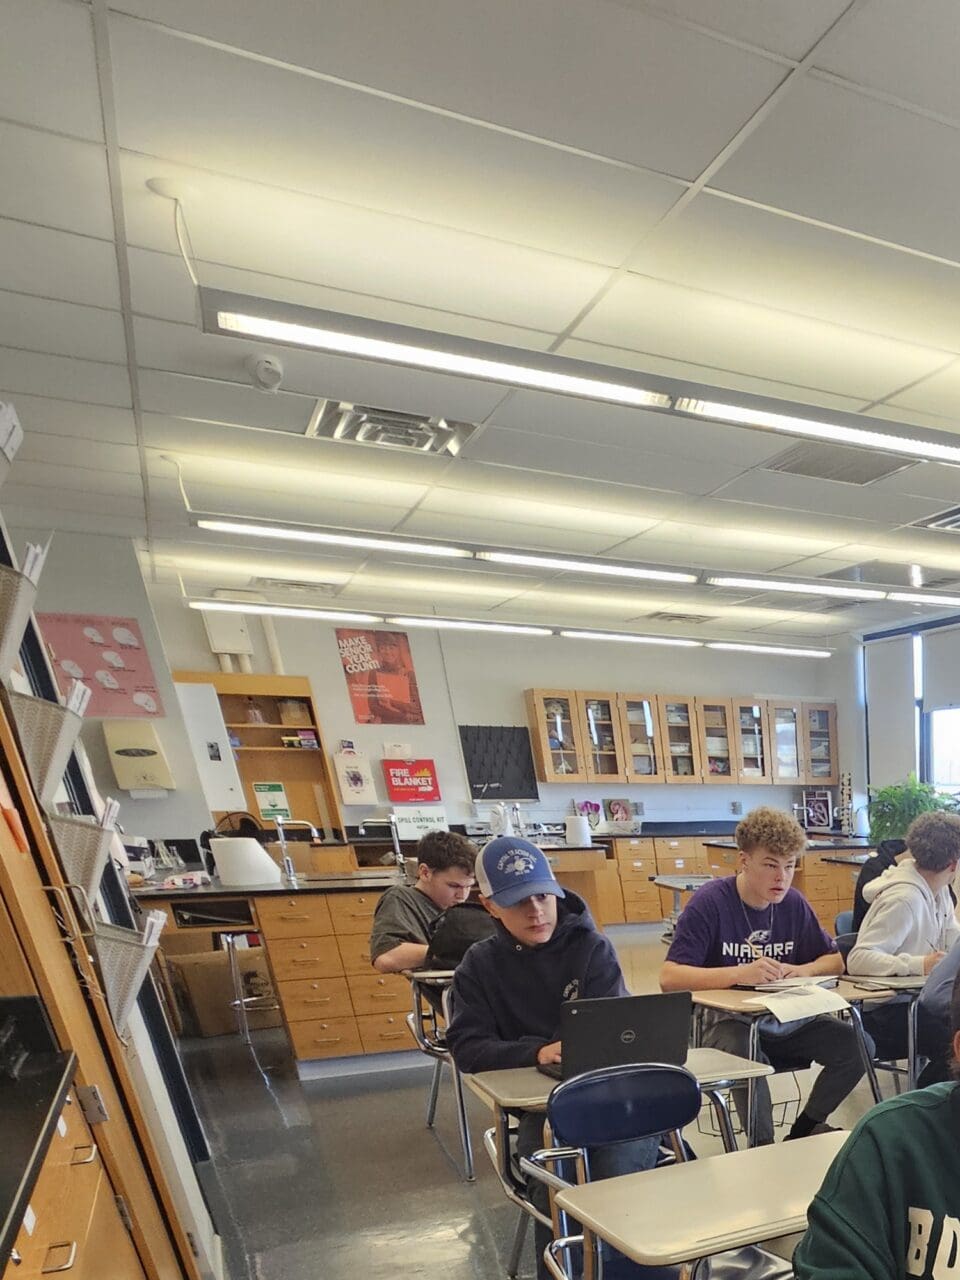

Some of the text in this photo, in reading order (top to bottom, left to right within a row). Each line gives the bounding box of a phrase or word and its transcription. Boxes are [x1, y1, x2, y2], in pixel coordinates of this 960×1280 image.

[338, 635, 368, 648] MAKE
[339, 644, 373, 658] SENIOR
[346, 653, 372, 664] YEAR
[389, 768, 410, 777] FIRE
[391, 777, 433, 786] BLANKET
[397, 816, 411, 824] SPILL
[412, 816, 436, 824] CONTROL
